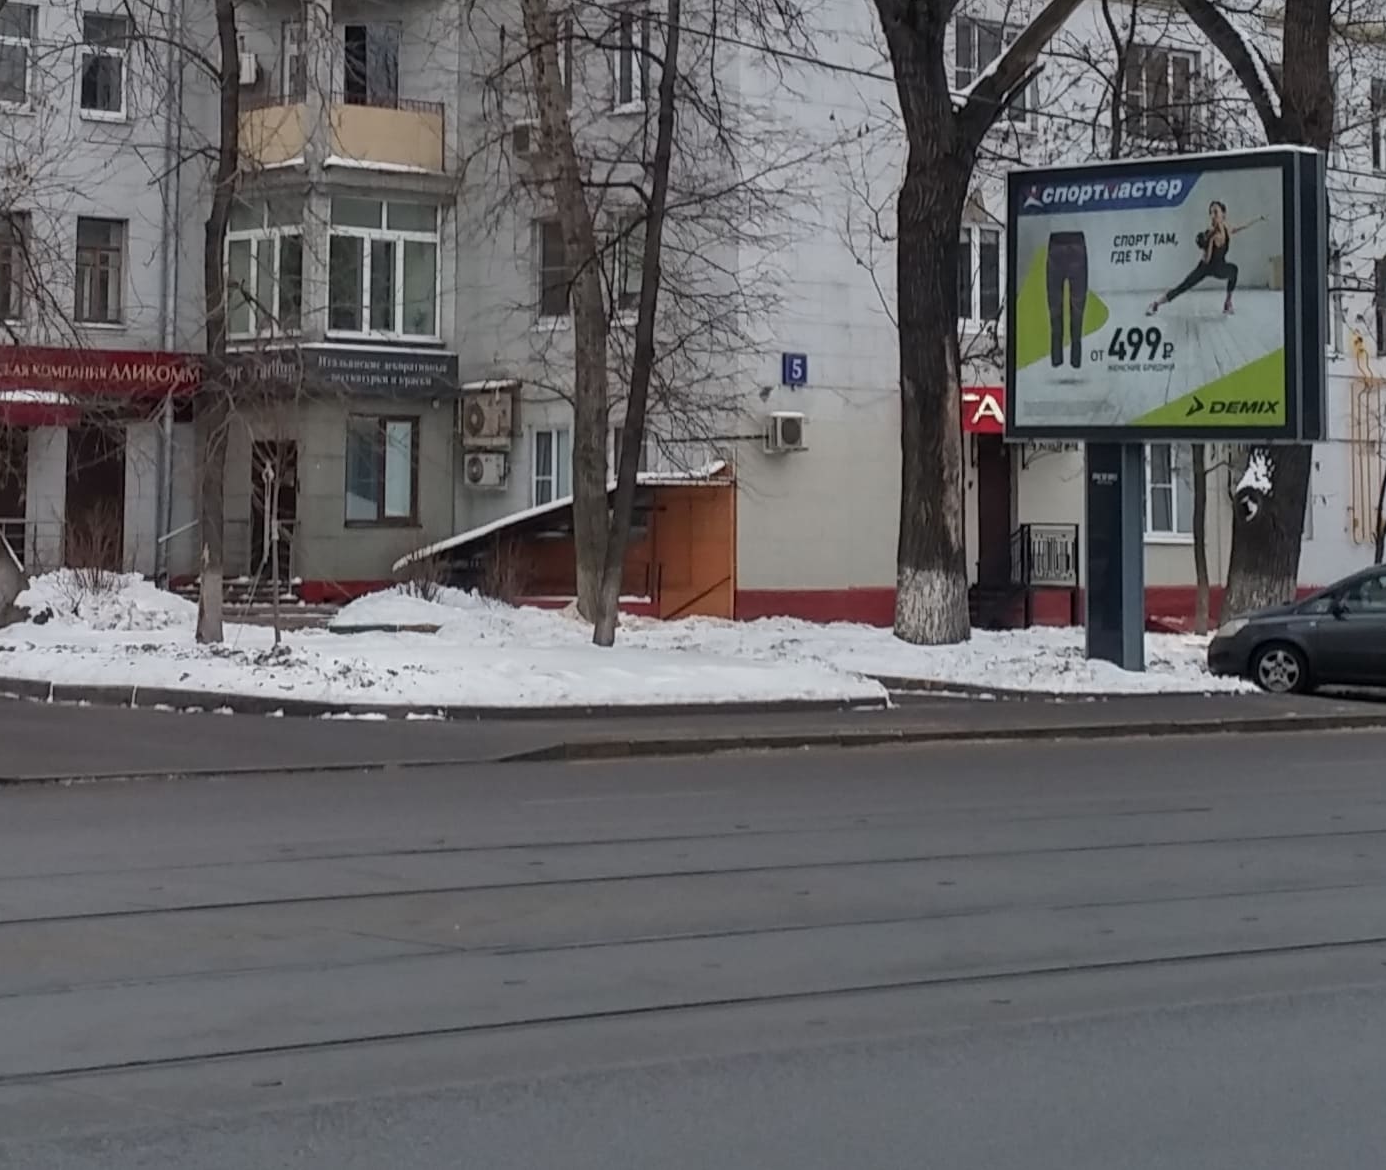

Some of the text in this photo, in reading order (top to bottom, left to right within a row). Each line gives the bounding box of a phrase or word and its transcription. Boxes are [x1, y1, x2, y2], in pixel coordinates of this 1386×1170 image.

[1042, 178, 1183, 206] спортмастер
[1113, 232, 1179, 248] СПОРТ ТАМ,
[1110, 250, 1153, 265] ГДЕ ТЫ
[109, 362, 200, 383] АЛИКОММ
[791, 358, 803, 379] 5
[1209, 400, 1280, 414] DEMIX
